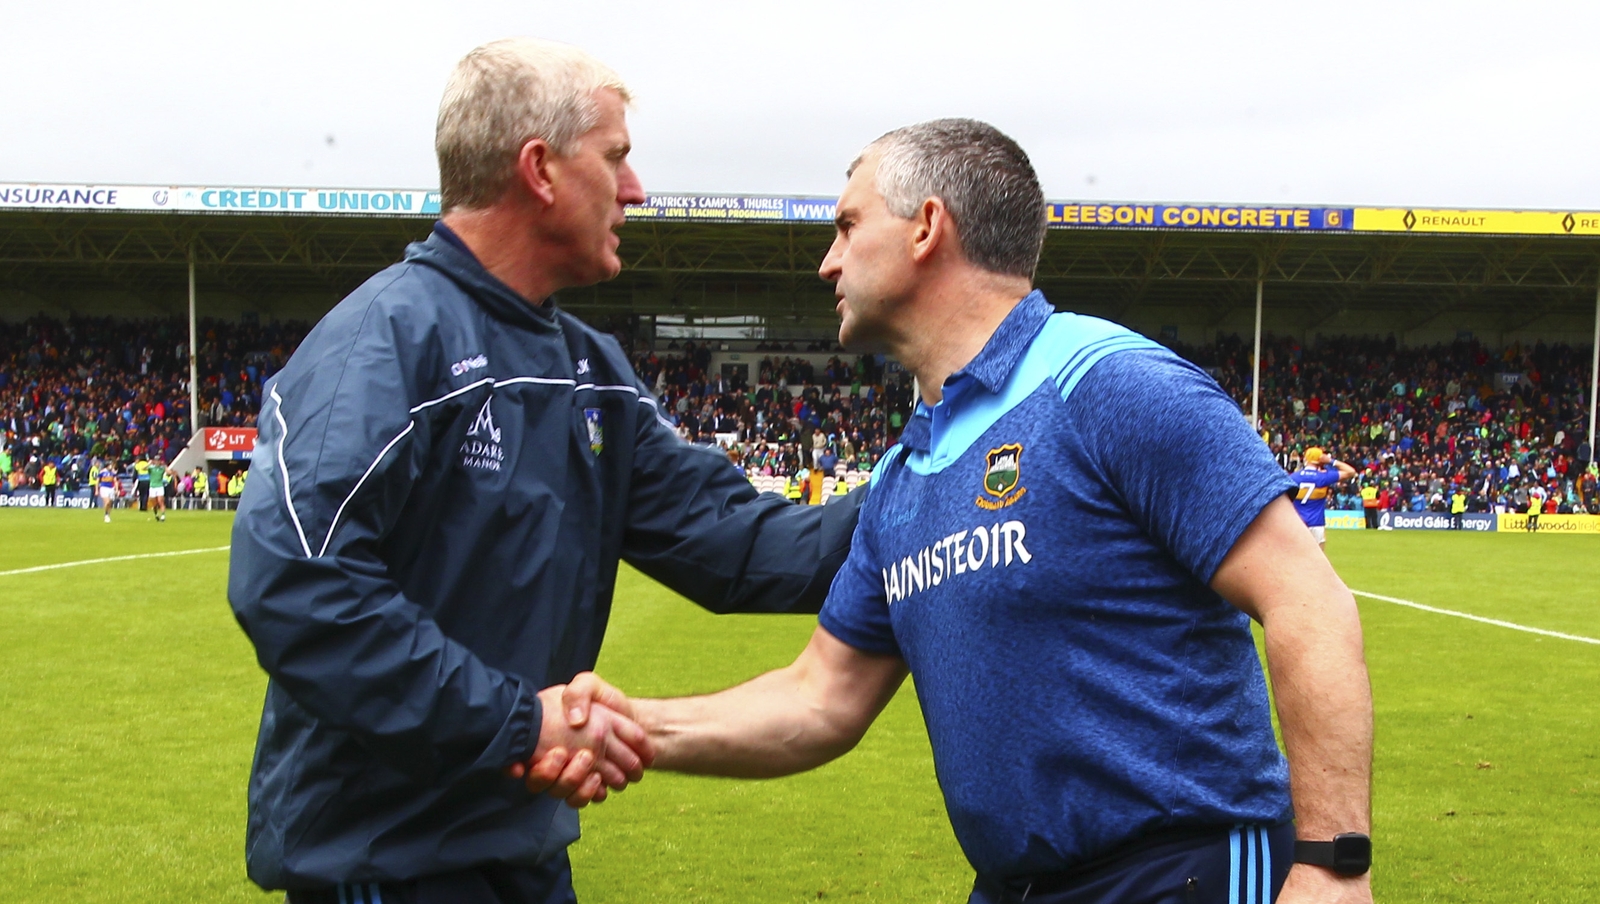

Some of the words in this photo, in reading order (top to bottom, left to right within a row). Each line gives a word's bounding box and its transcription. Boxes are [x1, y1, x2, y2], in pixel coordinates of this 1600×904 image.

[201, 190, 307, 209] CREDIT
[318, 192, 413, 211] UNION
[650, 196, 697, 208] PATRICK'S
[699, 196, 742, 210] CAMPUS,
[743, 198, 784, 210] THURLES
[623, 207, 659, 217] ONDARY
[665, 207, 687, 217] LEVEL
[689, 208, 727, 218] TEACHING
[728, 208, 784, 219] PROGRAMMES
[1047, 205, 1154, 224] LEESON
[1162, 208, 1310, 227] CONCRETE
[1422, 216, 1486, 227] RENAULT
[229, 434, 246, 445] LIT
[459, 440, 505, 462] ADARE
[1299, 482, 1316, 504] 7
[0, 494, 29, 507] Bord
[1394, 515, 1423, 528] Bord
[1424, 515, 1450, 529] Gáis
[1504, 518, 1577, 531] Littwoods
[882, 520, 1033, 607] AINISTEOIR
